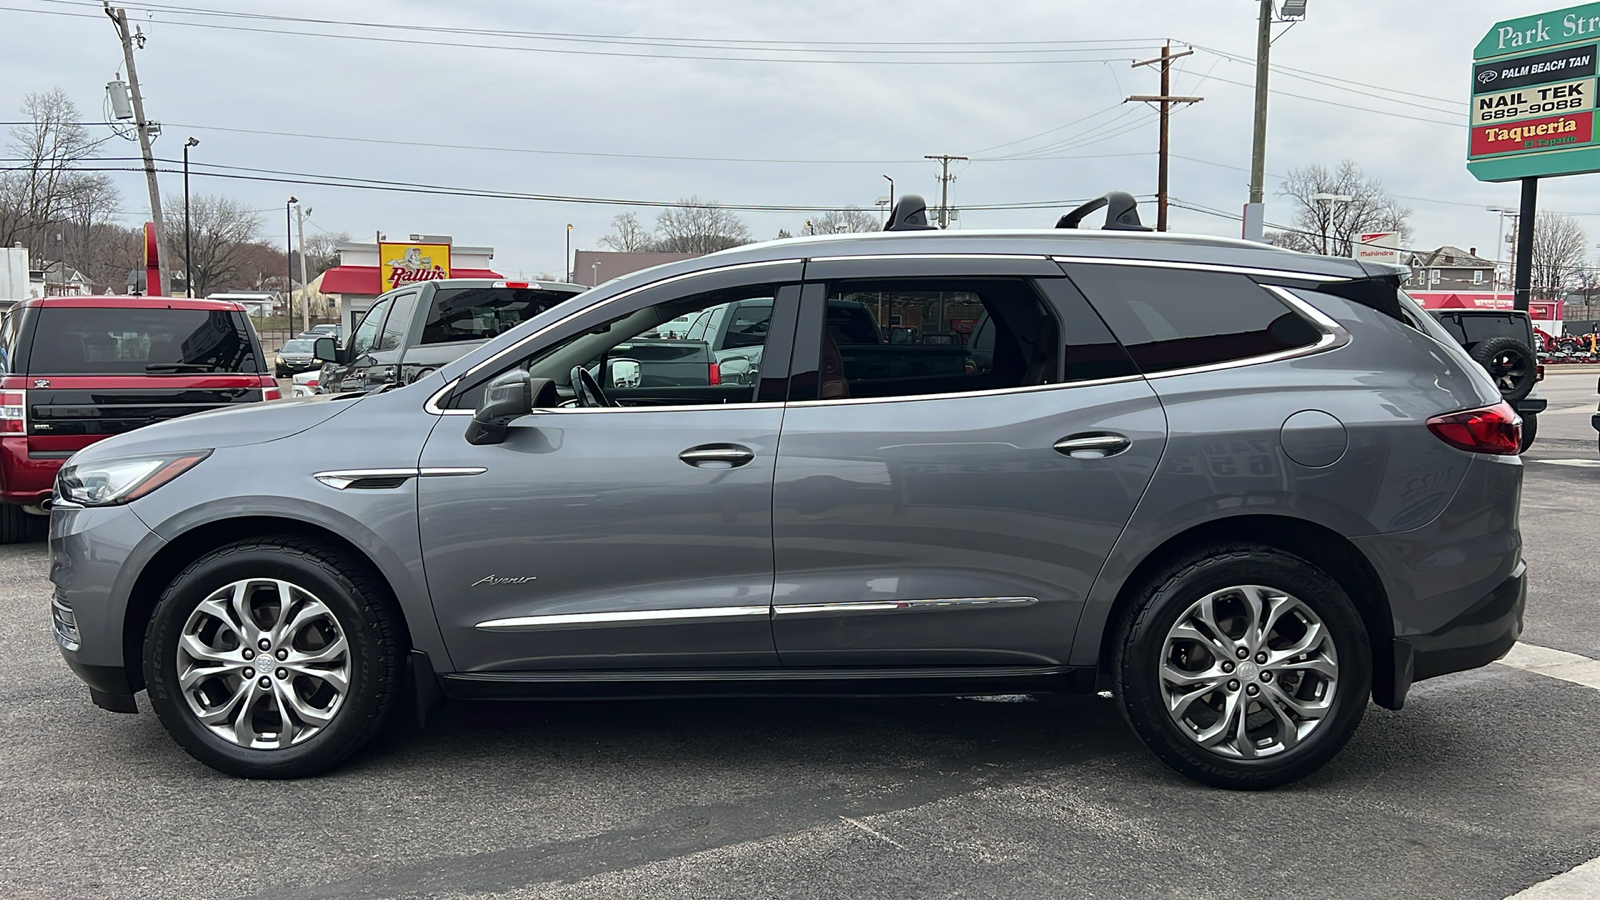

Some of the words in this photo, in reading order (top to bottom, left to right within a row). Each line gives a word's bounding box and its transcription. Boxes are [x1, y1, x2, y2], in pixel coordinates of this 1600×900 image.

[1497, 19, 1551, 50] Park
[1563, 14, 1600, 37] Str
[1501, 65, 1530, 79] PALM
[1531, 59, 1566, 74] BEACH
[1569, 55, 1590, 67] TAN
[1479, 93, 1528, 111] NAIL
[1537, 83, 1584, 101] TEK
[1481, 98, 1582, 121] 689-9088
[388, 265, 445, 289] Rally's
